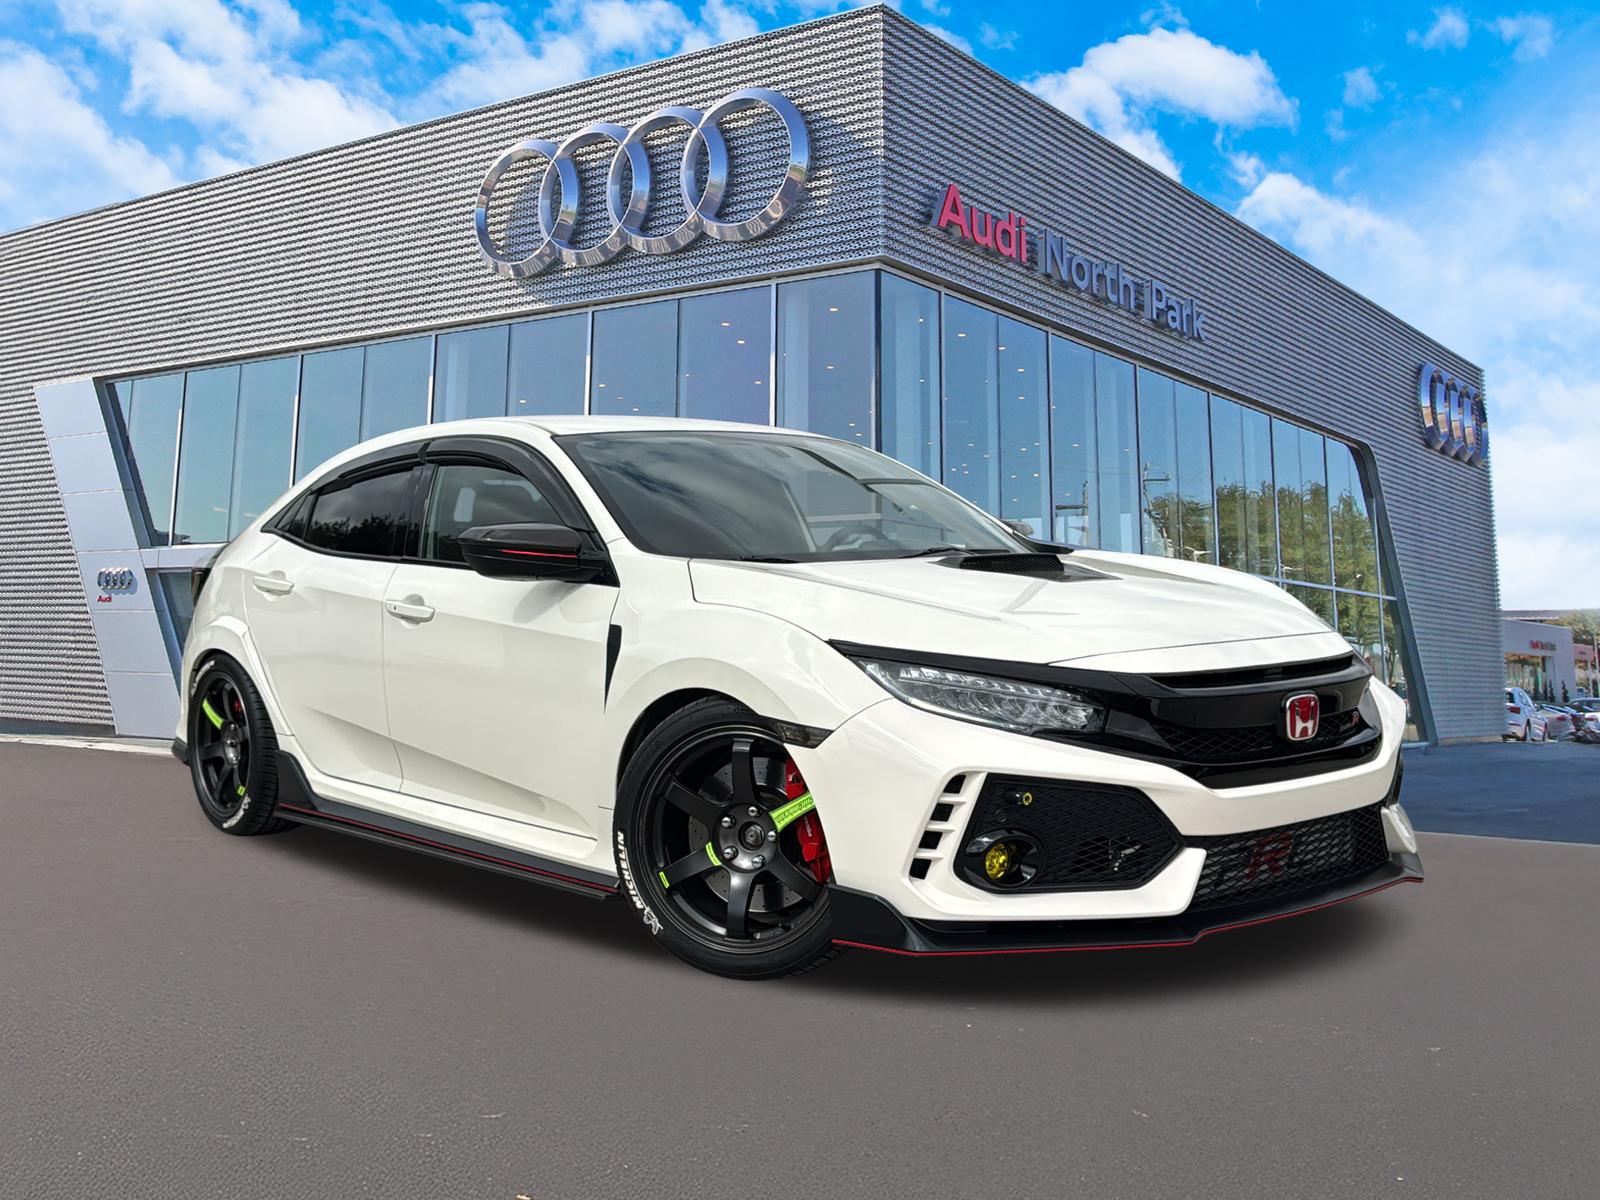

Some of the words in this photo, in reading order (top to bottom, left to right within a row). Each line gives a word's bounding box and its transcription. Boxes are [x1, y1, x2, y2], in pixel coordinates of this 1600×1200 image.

[935, 183, 1028, 263] Audi
[1040, 231, 1137, 313] North
[1144, 278, 1206, 341] Park
[617, 831, 644, 909] MICHELIN
